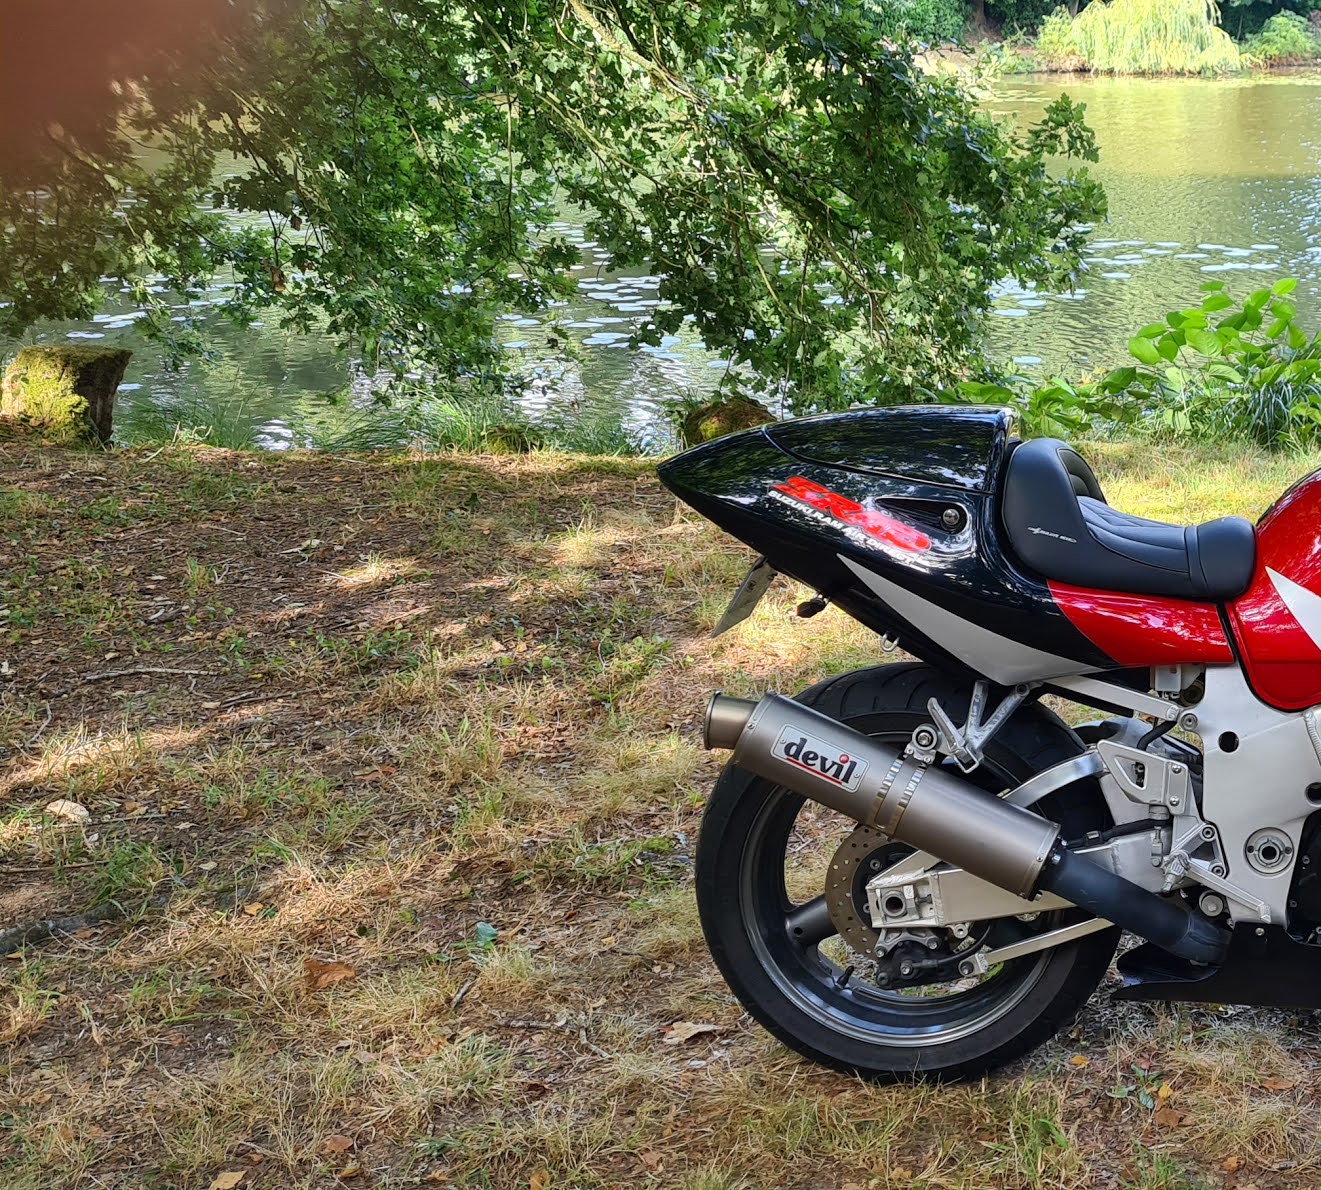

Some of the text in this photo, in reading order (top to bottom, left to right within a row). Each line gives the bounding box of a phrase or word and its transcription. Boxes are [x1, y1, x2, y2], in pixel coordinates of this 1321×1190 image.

[768, 490, 816, 517] SUZUKI
[812, 508, 844, 530] RAM
[843, 526, 871, 546] AIR
[784, 737, 857, 784] devil
